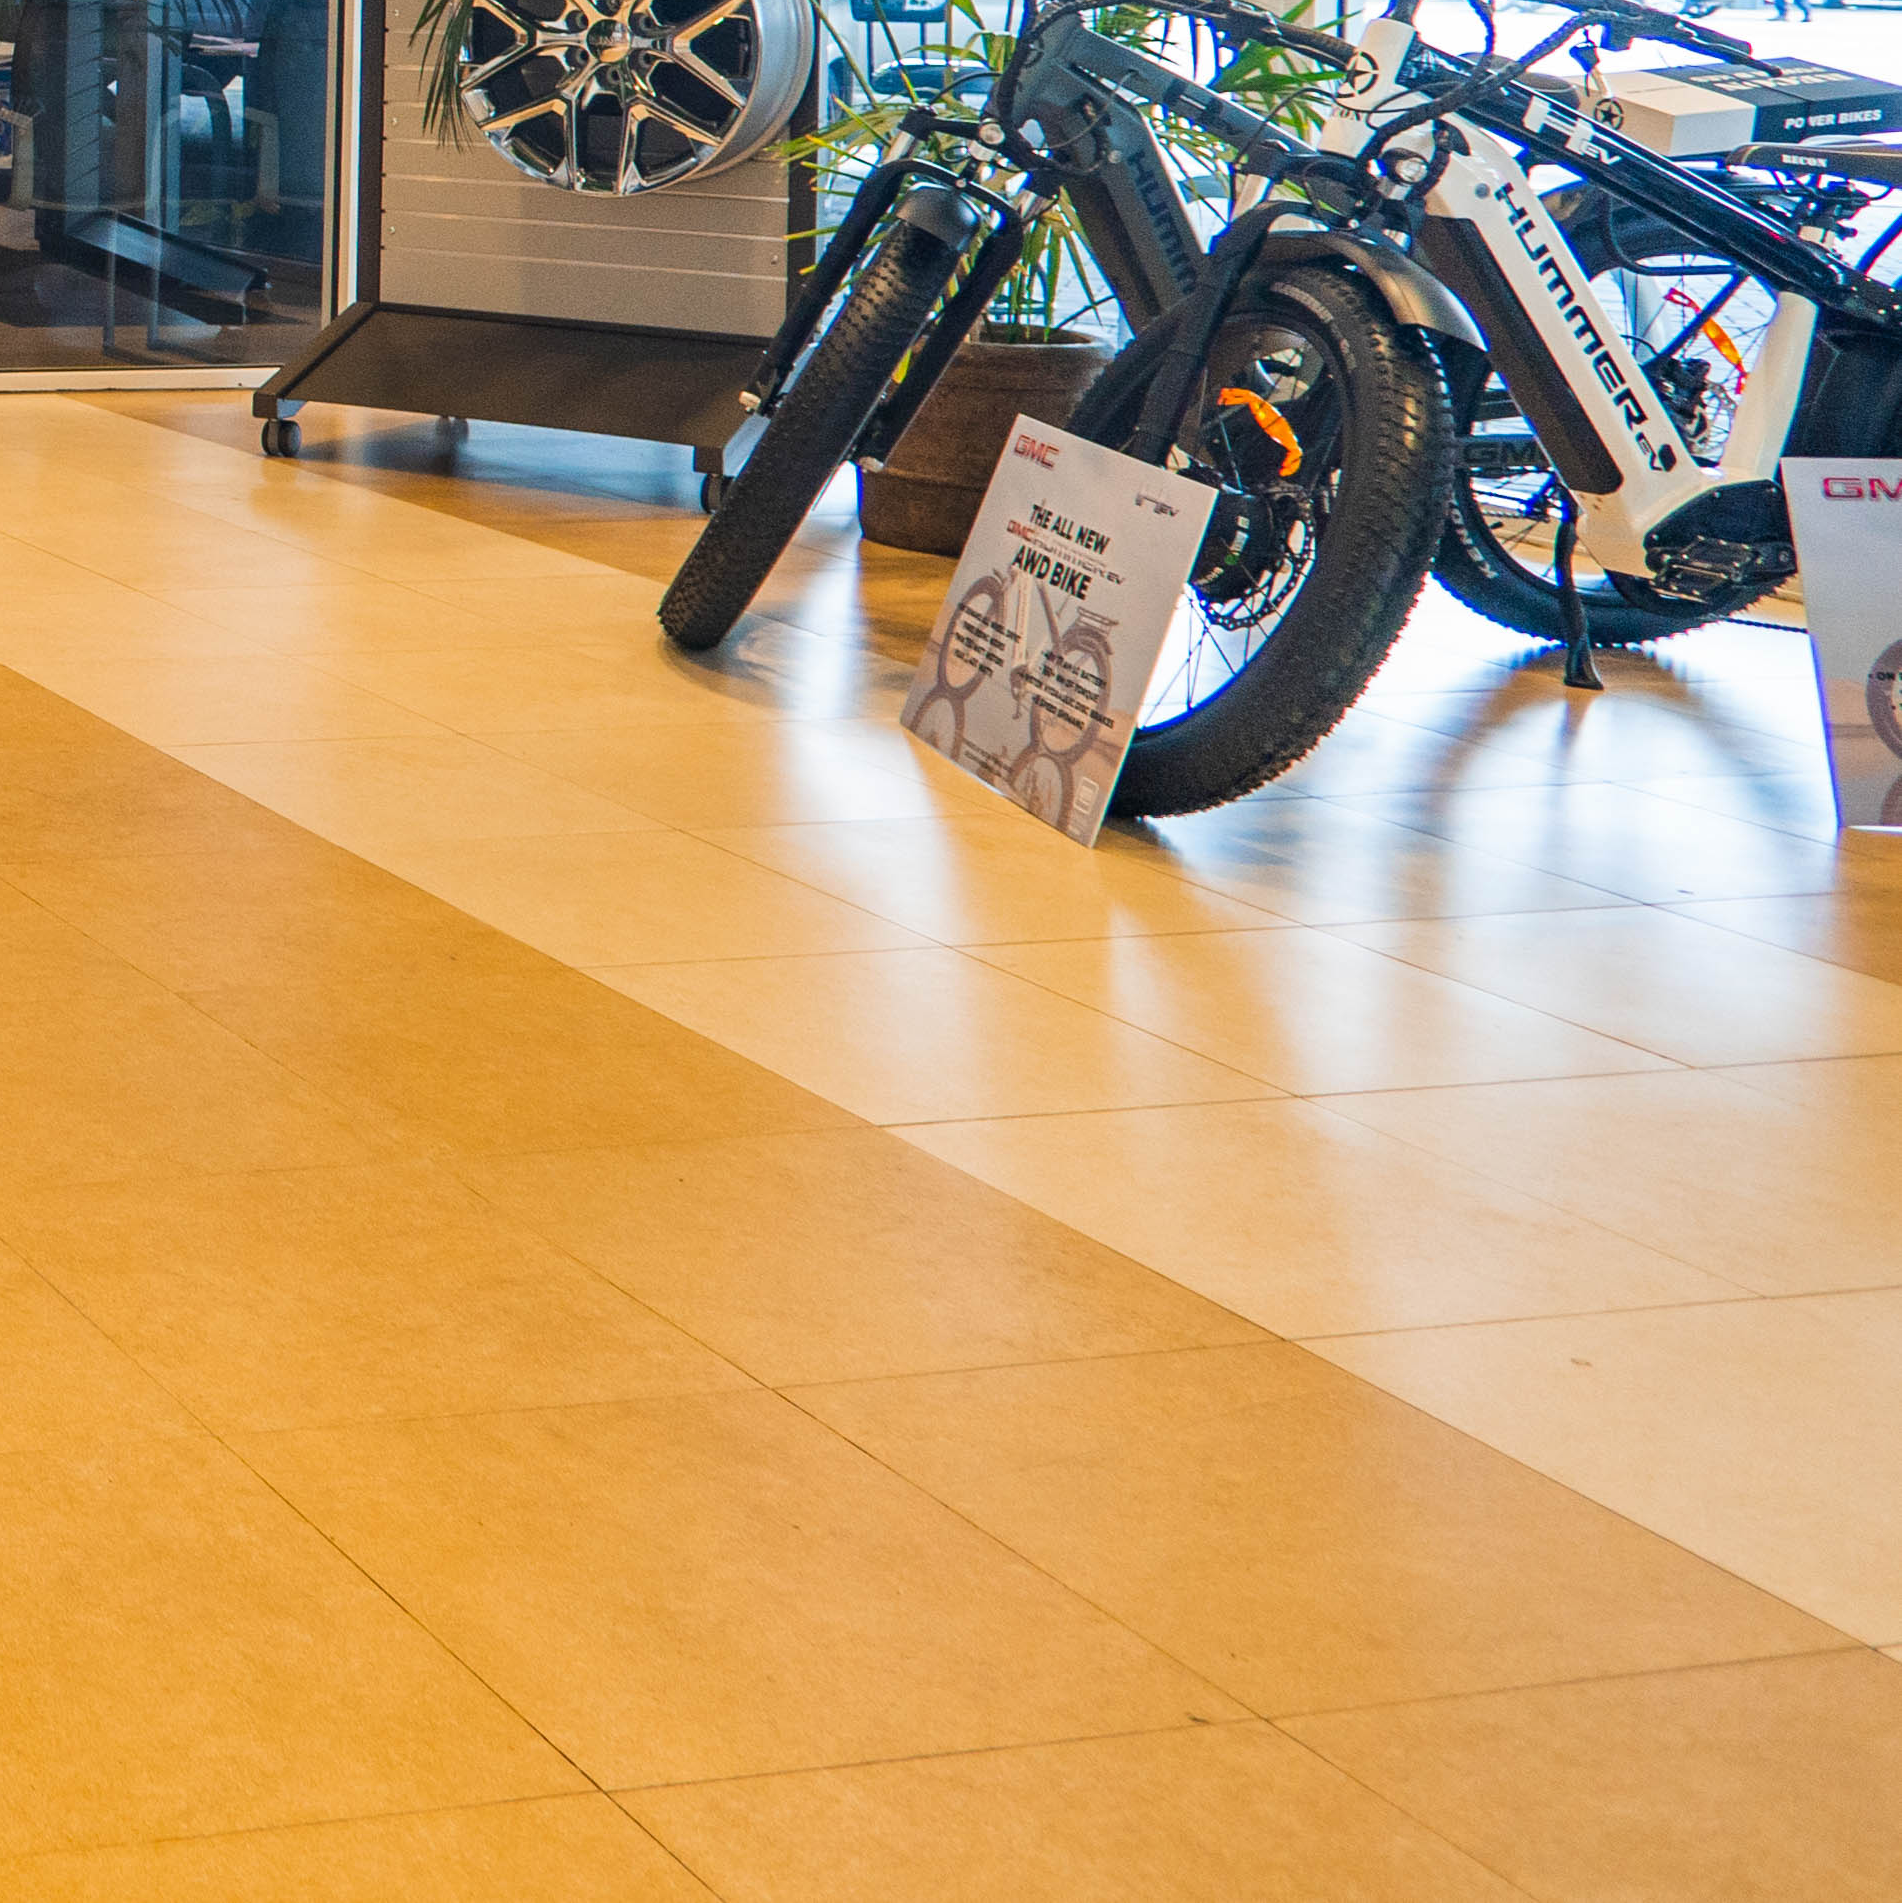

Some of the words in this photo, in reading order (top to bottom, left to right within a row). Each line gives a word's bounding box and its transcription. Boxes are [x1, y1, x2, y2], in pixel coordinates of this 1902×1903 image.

[1837, 108, 1883, 125] BIKES
[1781, 153, 1829, 169] RECON
[1494, 181, 1649, 432] HUMMER
[1013, 432, 1060, 472] GMC
[1822, 476, 1902, 501] GM
[1030, 503, 1054, 530] THE
[1050, 514, 1075, 541] ALL
[1074, 524, 1112, 555] NEW
[1010, 544, 1052, 580] AWD
[1048, 560, 1093, 601] BIKE
